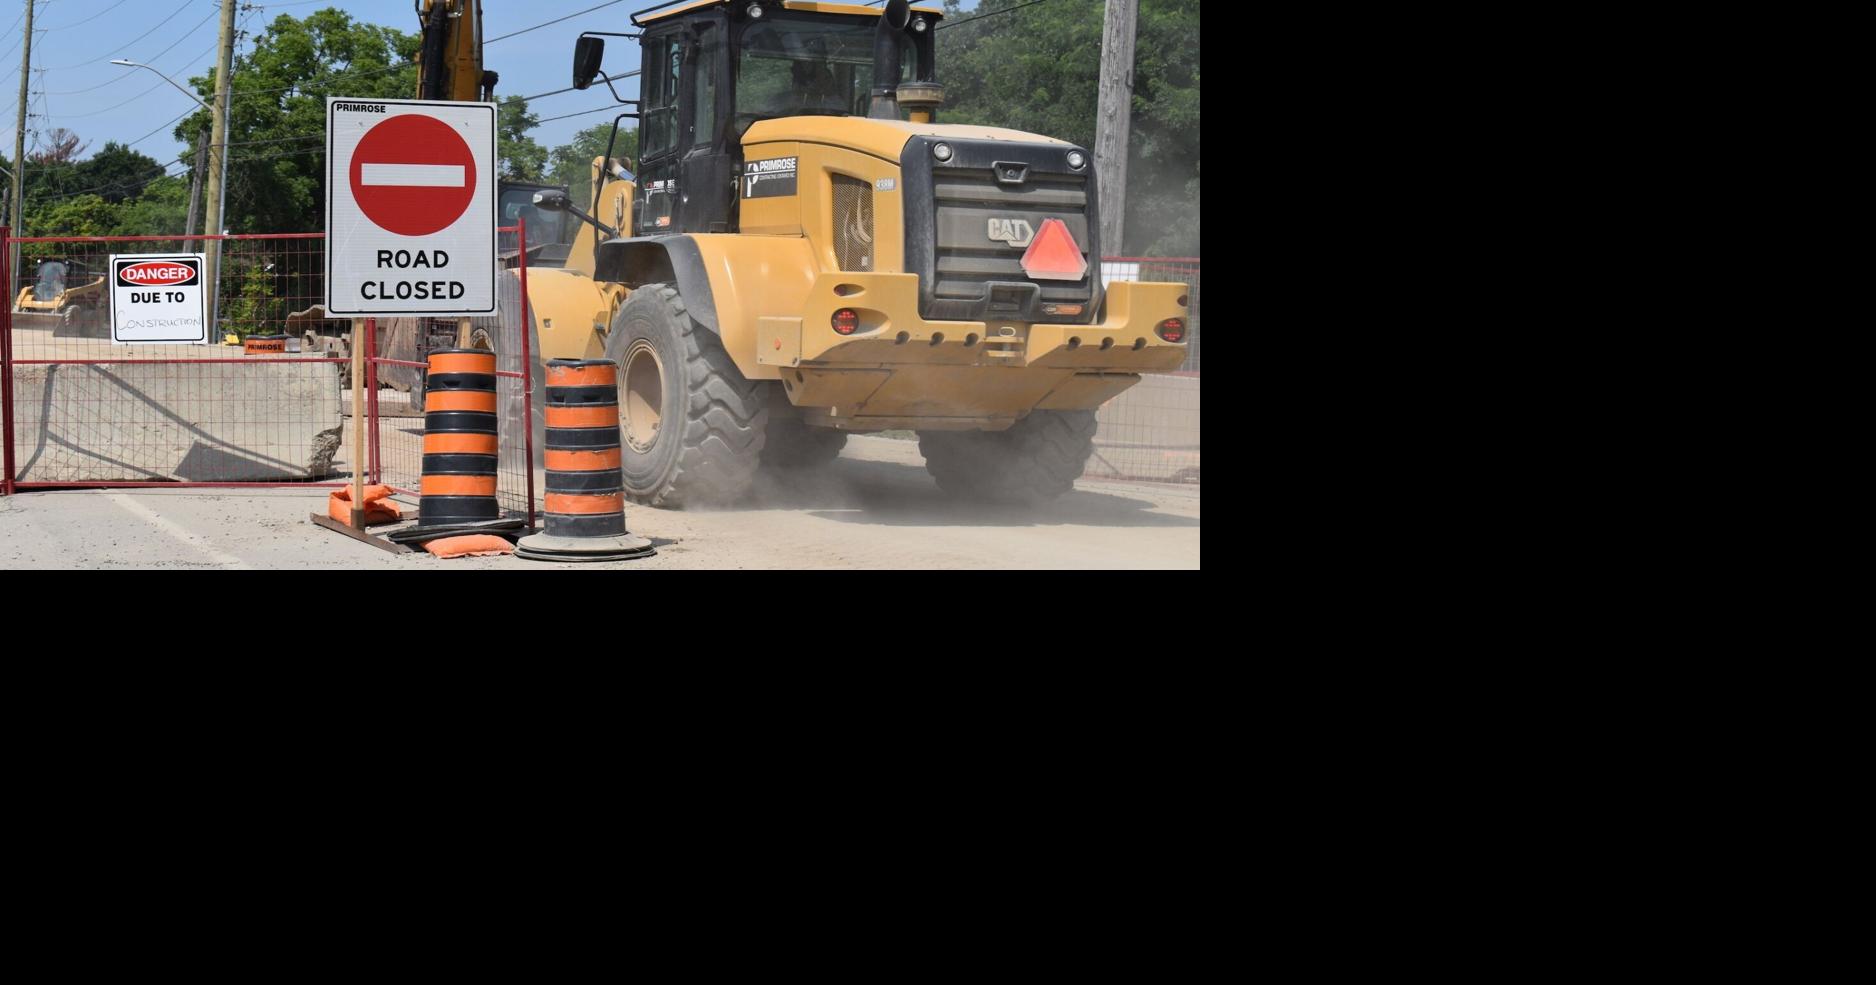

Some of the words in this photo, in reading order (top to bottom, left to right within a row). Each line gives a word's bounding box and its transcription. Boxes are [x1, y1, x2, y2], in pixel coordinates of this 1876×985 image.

[336, 103, 386, 113] PRIMROSE
[760, 157, 796, 172] PRIMROSE
[988, 218, 1028, 242] CAT
[377, 249, 449, 269] ROAD
[126, 267, 188, 280] DANGER
[131, 292, 161, 304] DUE
[165, 291, 186, 303] TO
[360, 281, 465, 300] CLOSED
